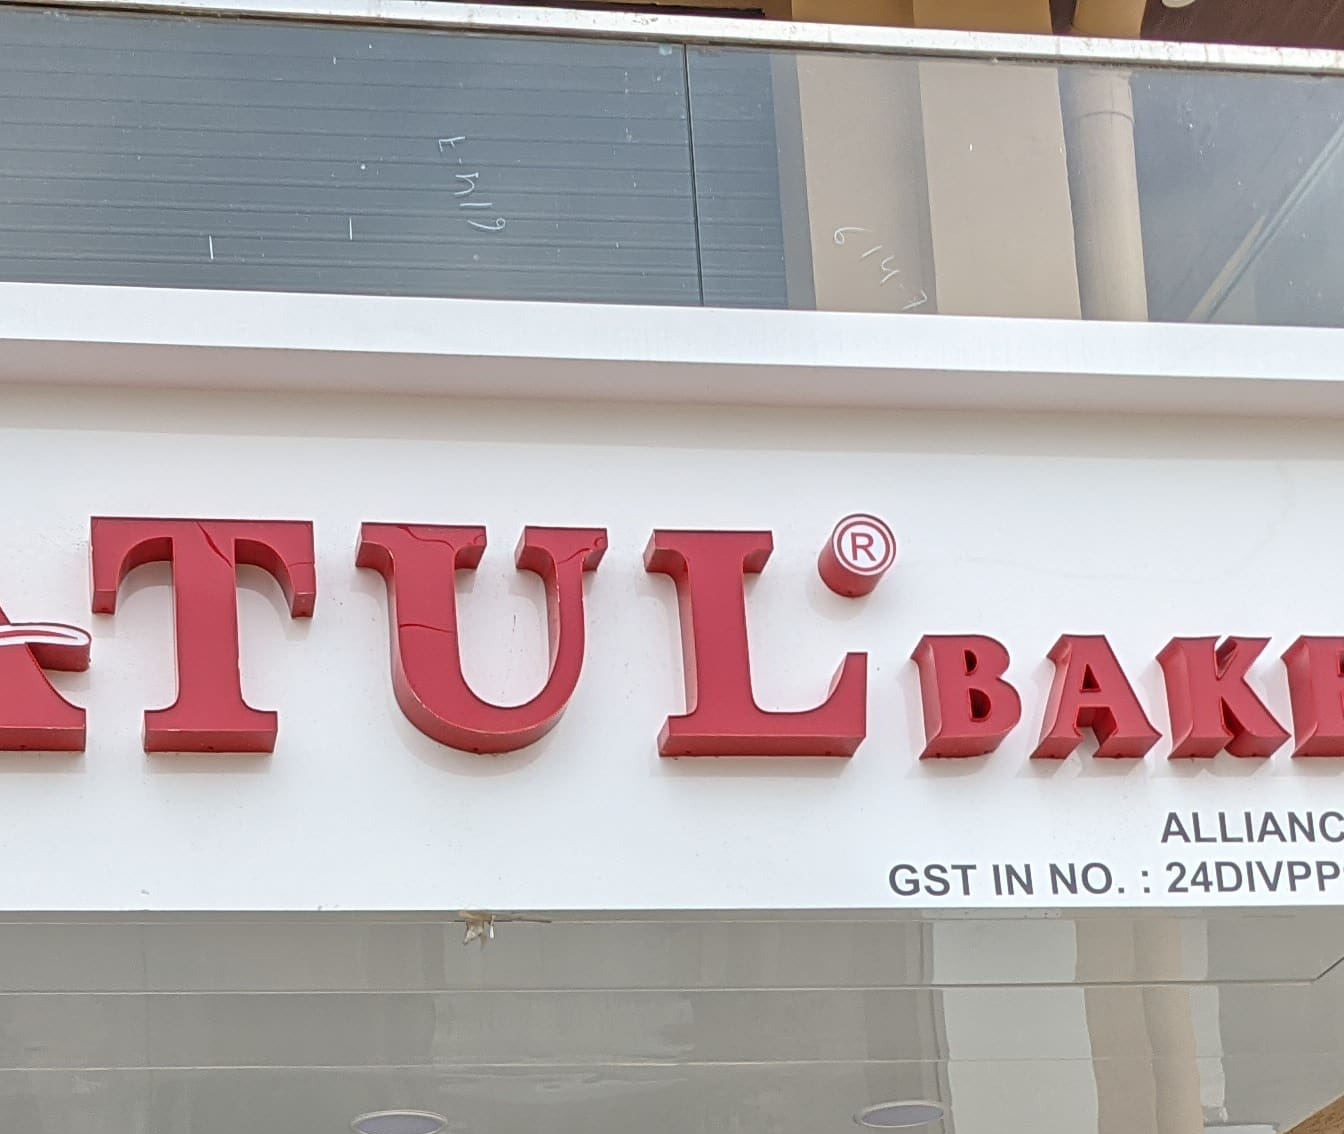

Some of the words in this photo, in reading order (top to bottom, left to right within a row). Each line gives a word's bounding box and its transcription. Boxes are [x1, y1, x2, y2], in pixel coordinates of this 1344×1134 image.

[888, 863, 977, 897] GST
[992, 863, 1034, 896] IN
[1049, 862, 1126, 895] NO.
